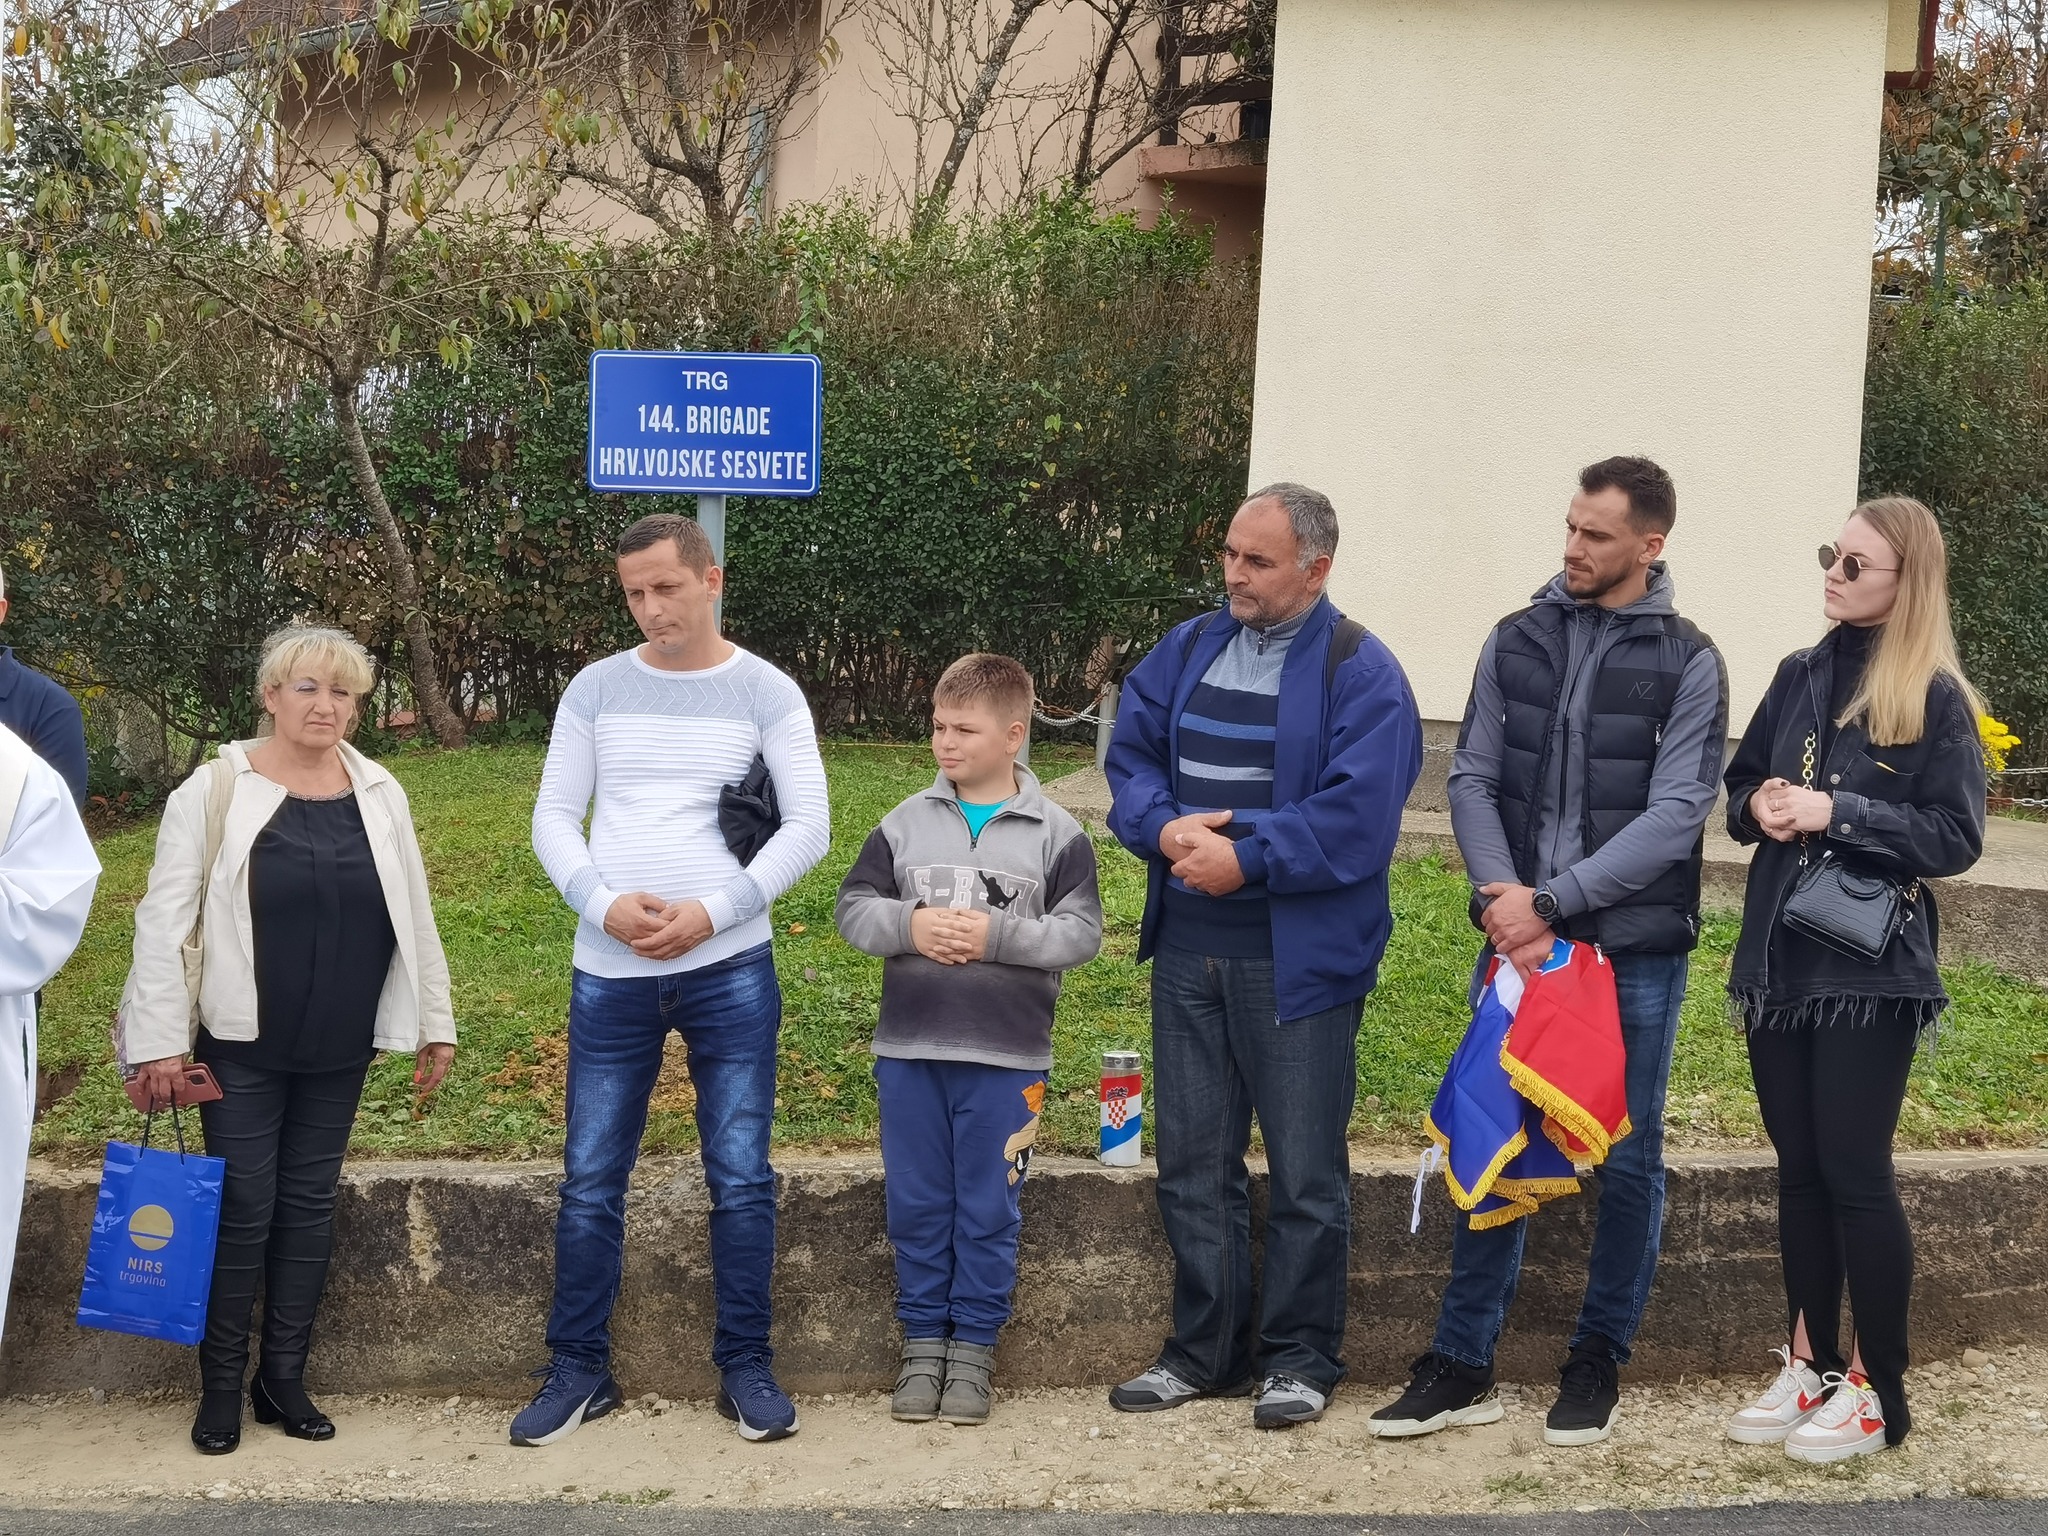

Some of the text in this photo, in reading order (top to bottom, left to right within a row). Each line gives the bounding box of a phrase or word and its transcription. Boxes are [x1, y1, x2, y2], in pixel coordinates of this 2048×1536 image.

[682, 371, 728, 390] TRG
[638, 405, 771, 435] 144. BRIGADE
[721, 450, 807, 480] SESVETE
[127, 1257, 164, 1274] NIRS
[119, 1270, 167, 1287] trgovina
